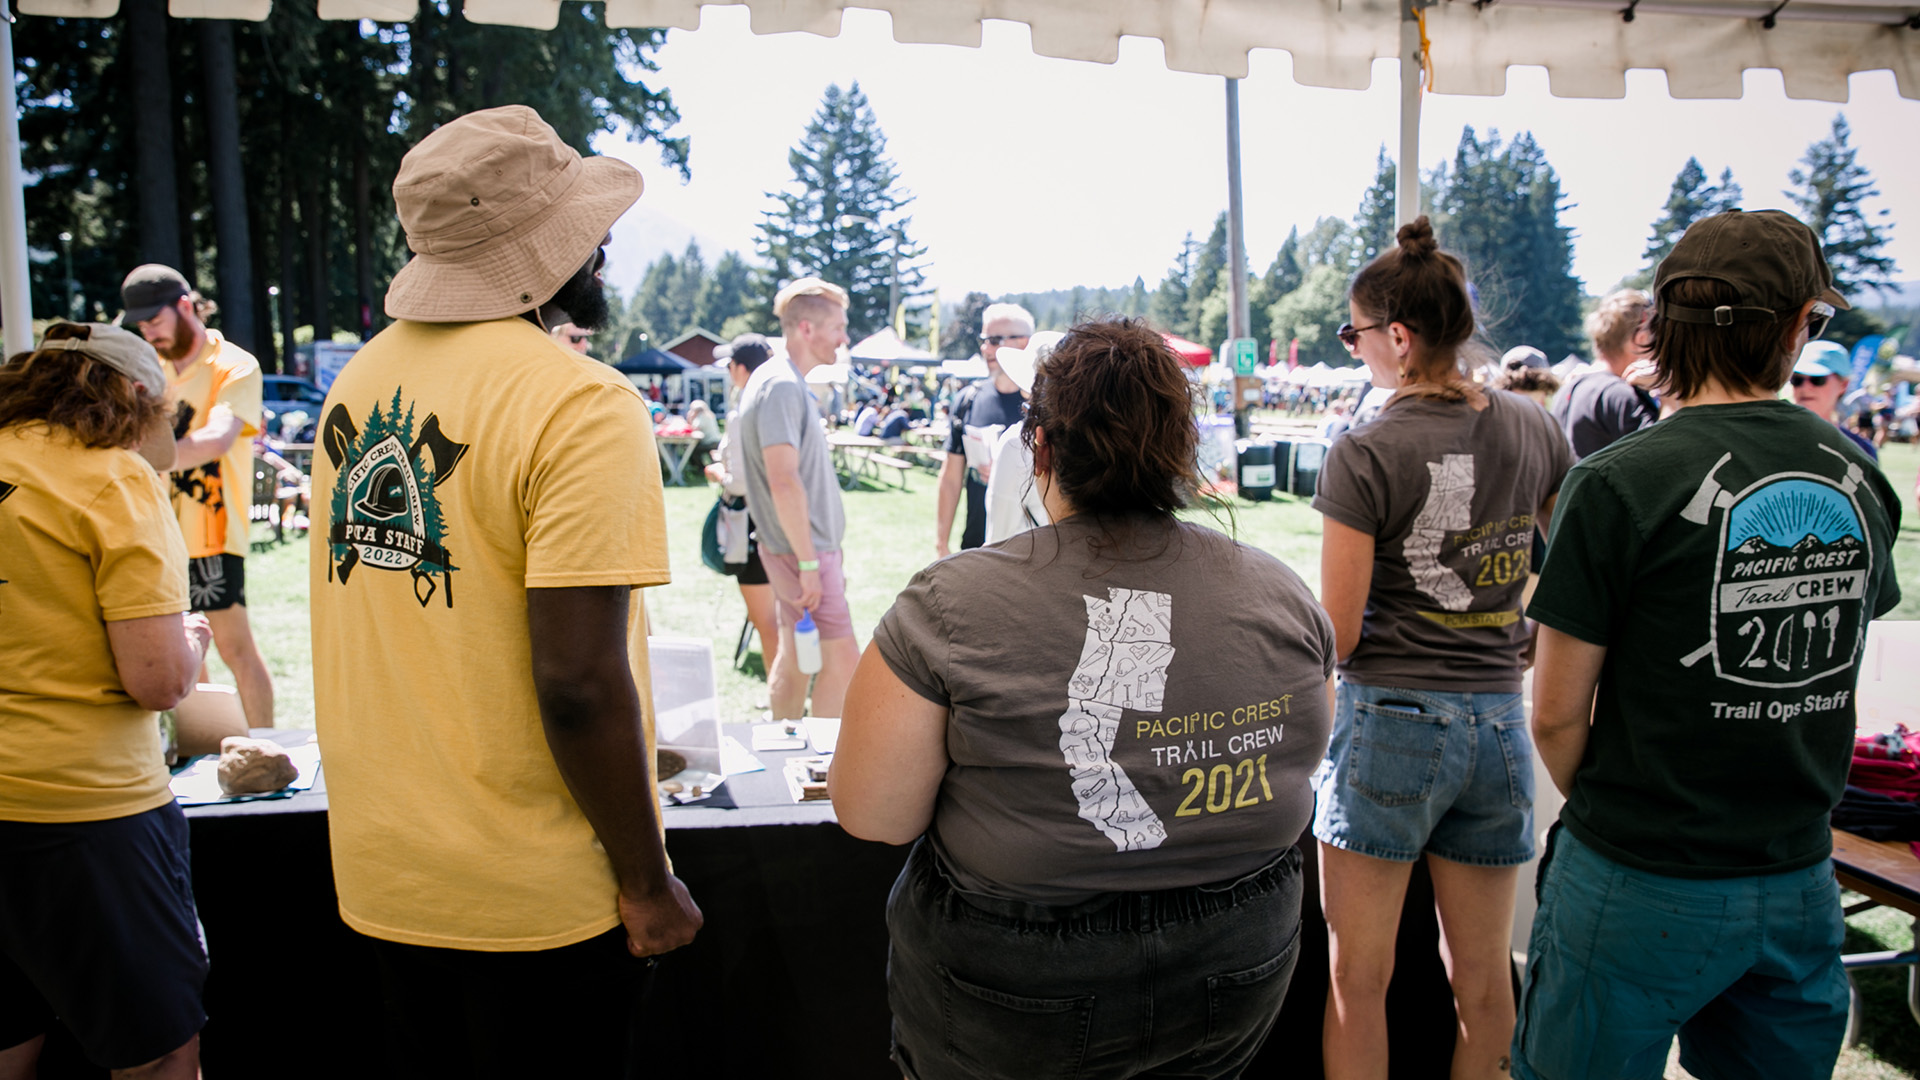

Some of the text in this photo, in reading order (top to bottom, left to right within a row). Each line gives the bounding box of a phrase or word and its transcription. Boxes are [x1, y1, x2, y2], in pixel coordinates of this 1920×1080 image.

[348, 459, 370, 491] CIFIC
[1508, 514, 1536, 530] CRE
[384, 529, 424, 555] STAFF
[1505, 531, 1532, 547] CRE
[363, 546, 402, 565] 2022
[1731, 550, 1860, 578] PACIFIC CREST
[1735, 576, 1855, 608] Trail CREW
[1471, 613, 1505, 625] STAFF
[1737, 605, 1840, 671] 2019
[1136, 694, 1293, 739] PACIFIC CREST
[1710, 690, 1849, 723] Trail Ops Staff
[1151, 724, 1284, 767] TRAIL CREW
[1175, 753, 1273, 817] 2021
